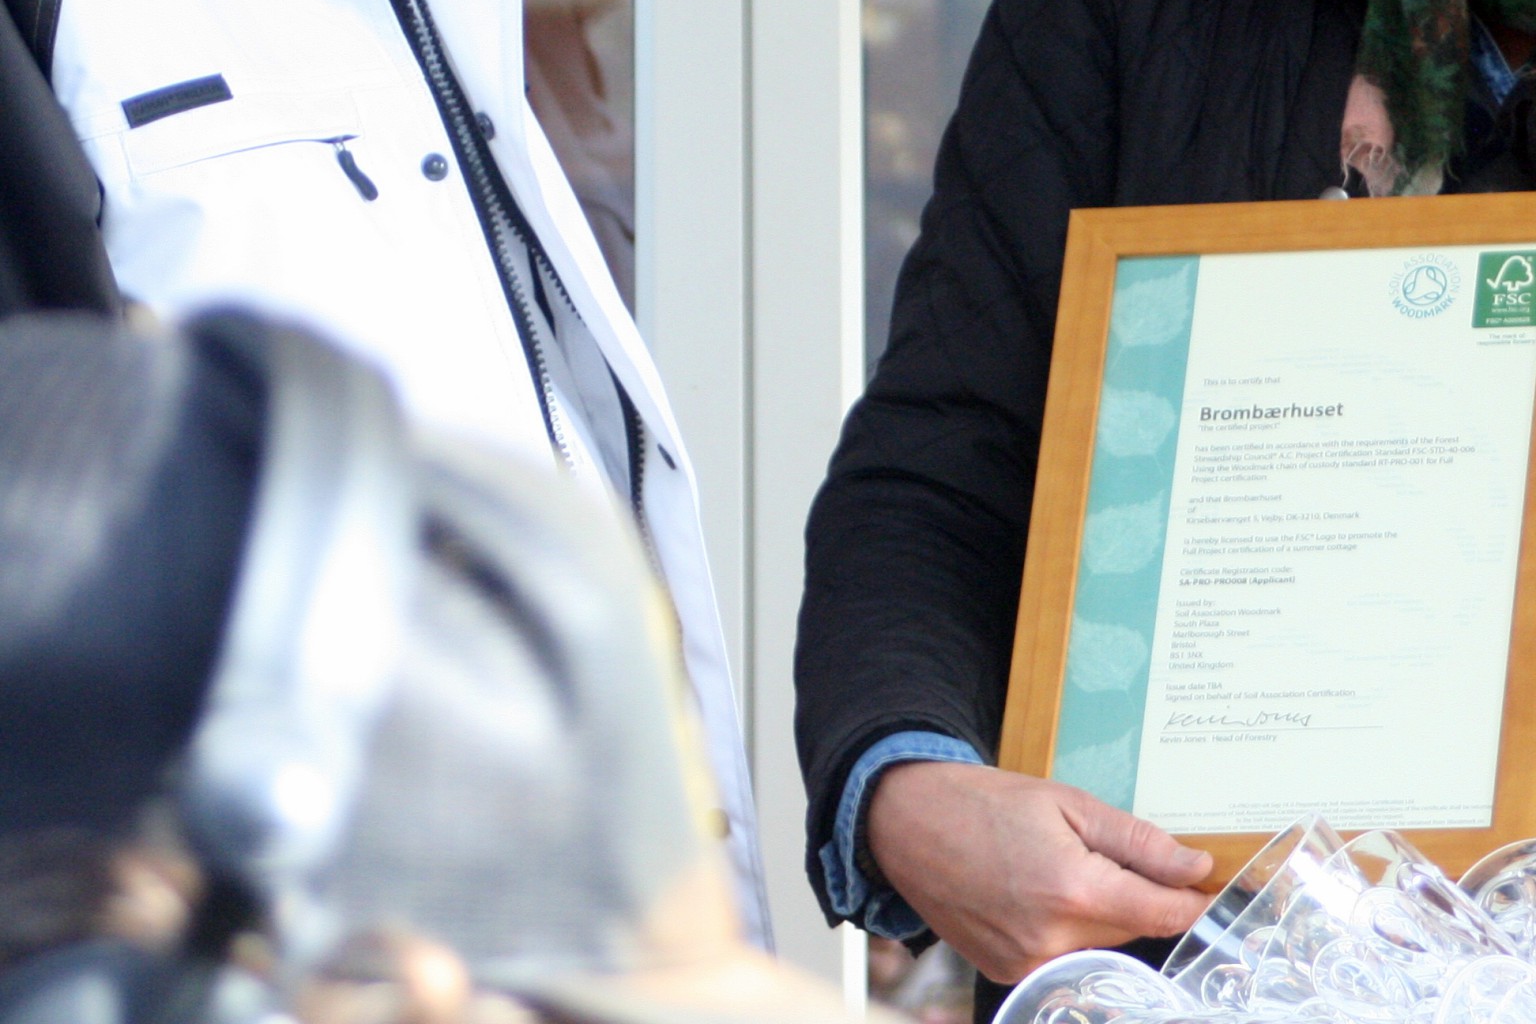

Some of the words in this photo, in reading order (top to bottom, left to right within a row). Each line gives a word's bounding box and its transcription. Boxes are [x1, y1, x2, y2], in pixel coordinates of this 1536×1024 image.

[1493, 293, 1531, 306] FSC
[1392, 296, 1456, 319] WOODMARK
[1199, 401, 1344, 421] Brombærhuset
[1231, 443, 1264, 451] certified
[1321, 440, 1339, 448] with
[1355, 439, 1408, 448] requirements
[1308, 461, 1339, 469] custody
[1164, 694, 1192, 702] Signed
[1244, 733, 1277, 741] Forestry
